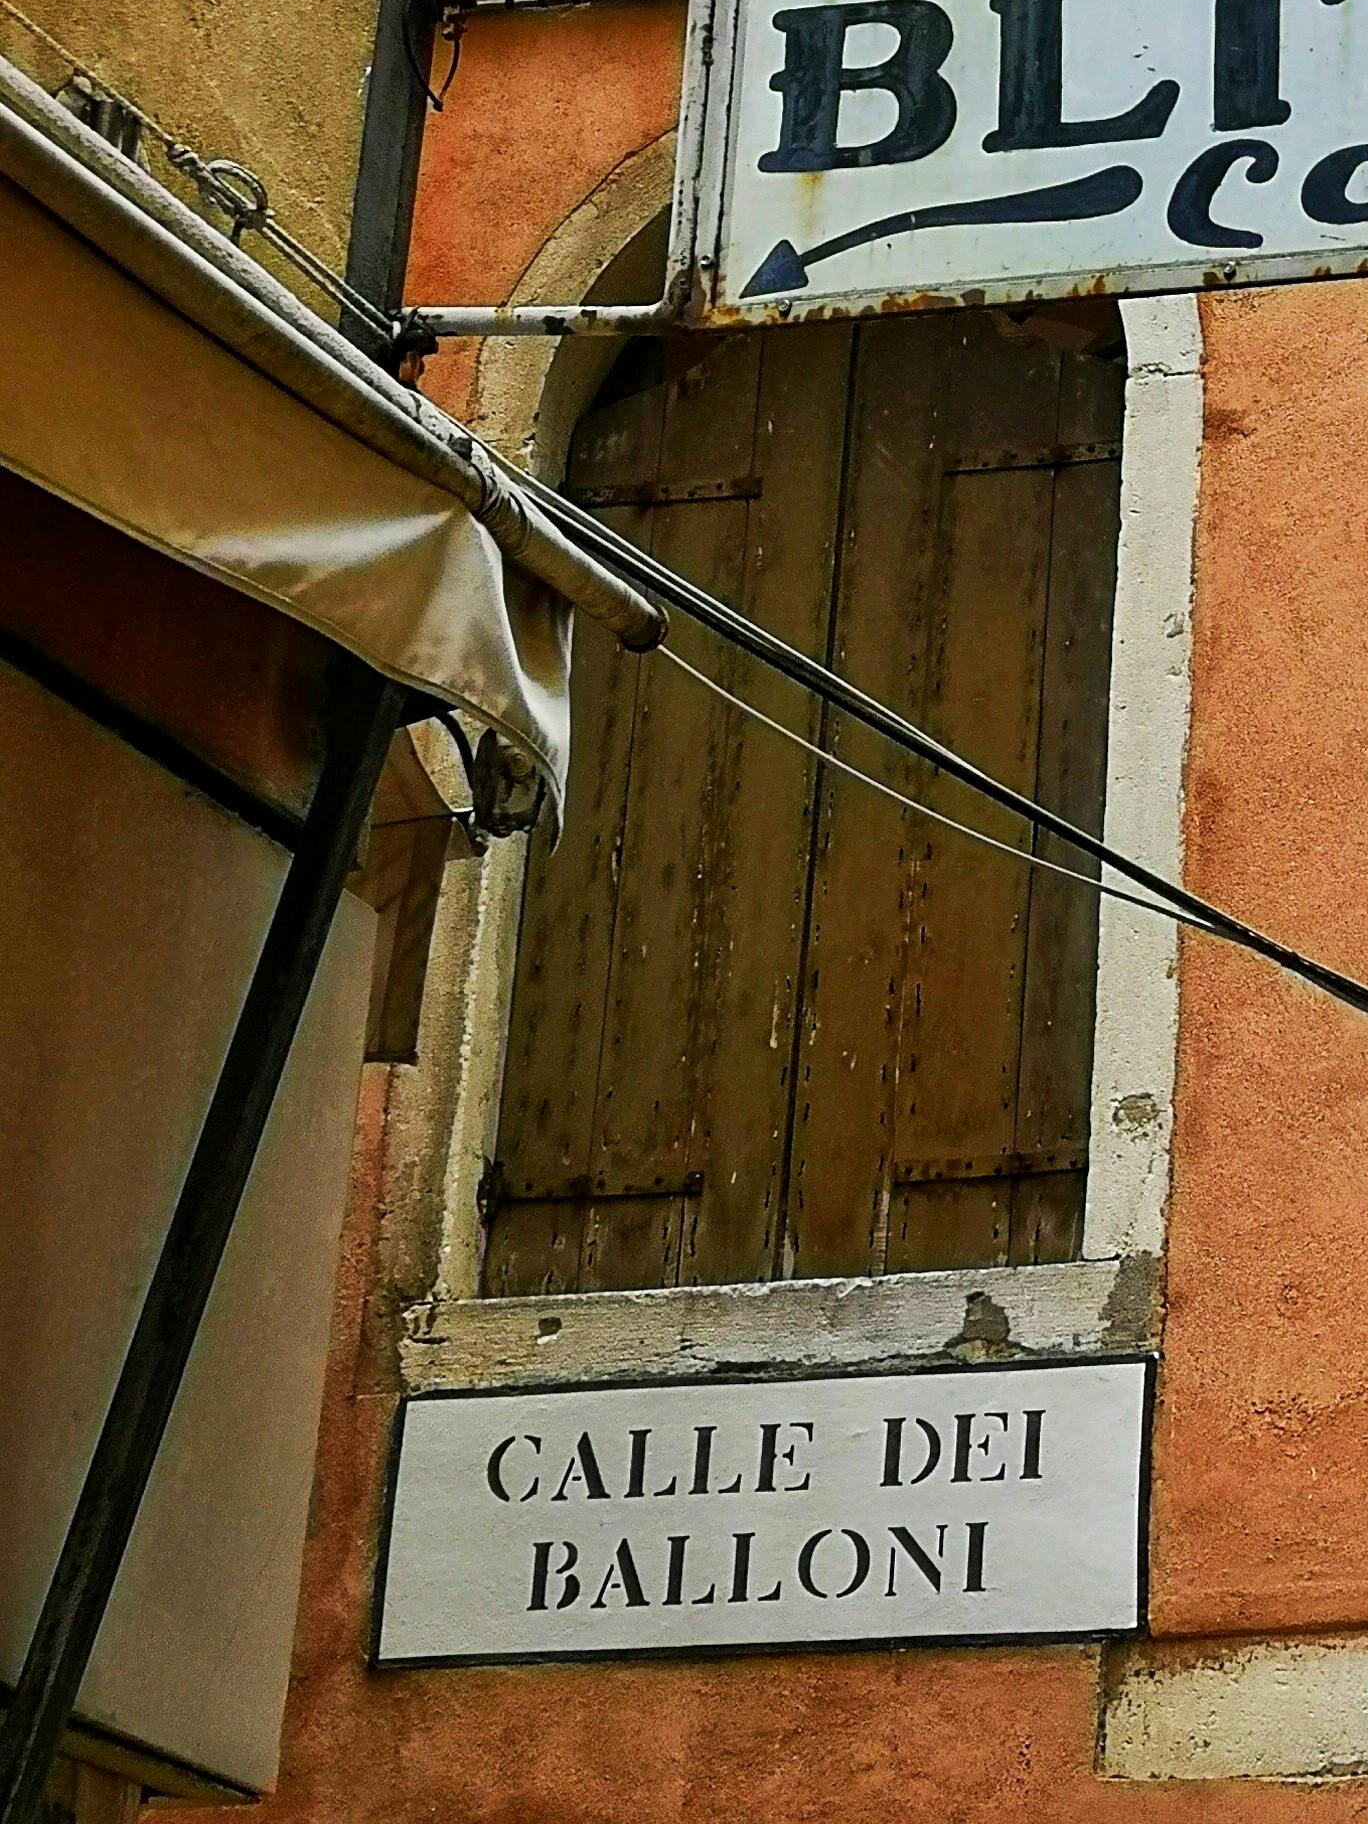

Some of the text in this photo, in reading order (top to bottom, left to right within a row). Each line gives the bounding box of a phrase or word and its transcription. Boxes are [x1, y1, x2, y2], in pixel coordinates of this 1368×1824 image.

[486, 1408, 1047, 1503] CALLE DEI
[526, 1521, 989, 1611] BALLONI
